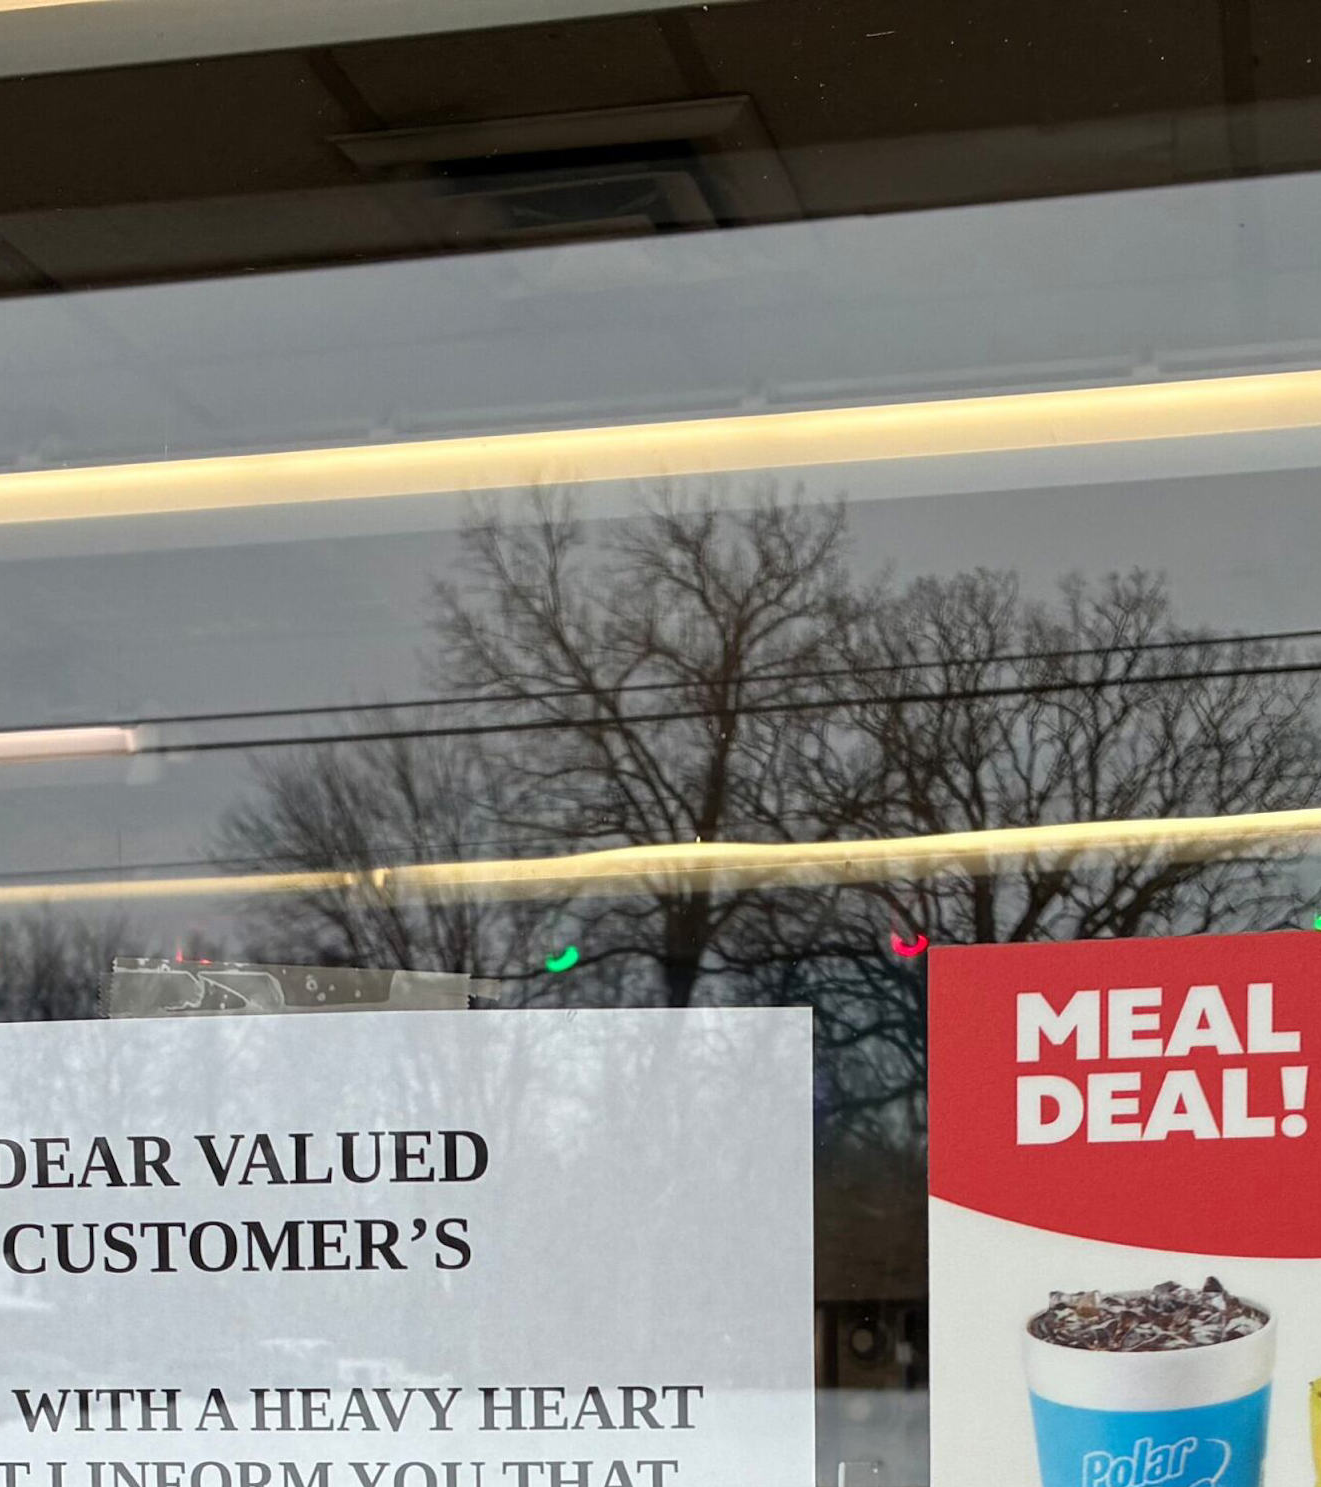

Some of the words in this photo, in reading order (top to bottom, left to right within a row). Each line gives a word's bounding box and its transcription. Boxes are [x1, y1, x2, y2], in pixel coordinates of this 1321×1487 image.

[1016, 982, 1301, 1063] MEAL
[1016, 1065, 1308, 1146] DEAL!
[193, 1130, 490, 1187] VALUED
[2, 1217, 473, 1275] CUSTOMER’S
[11, 1387, 182, 1433] WITH
[195, 1388, 238, 1432] A
[249, 1386, 462, 1432] HEAVY
[477, 1385, 704, 1432] HEART
